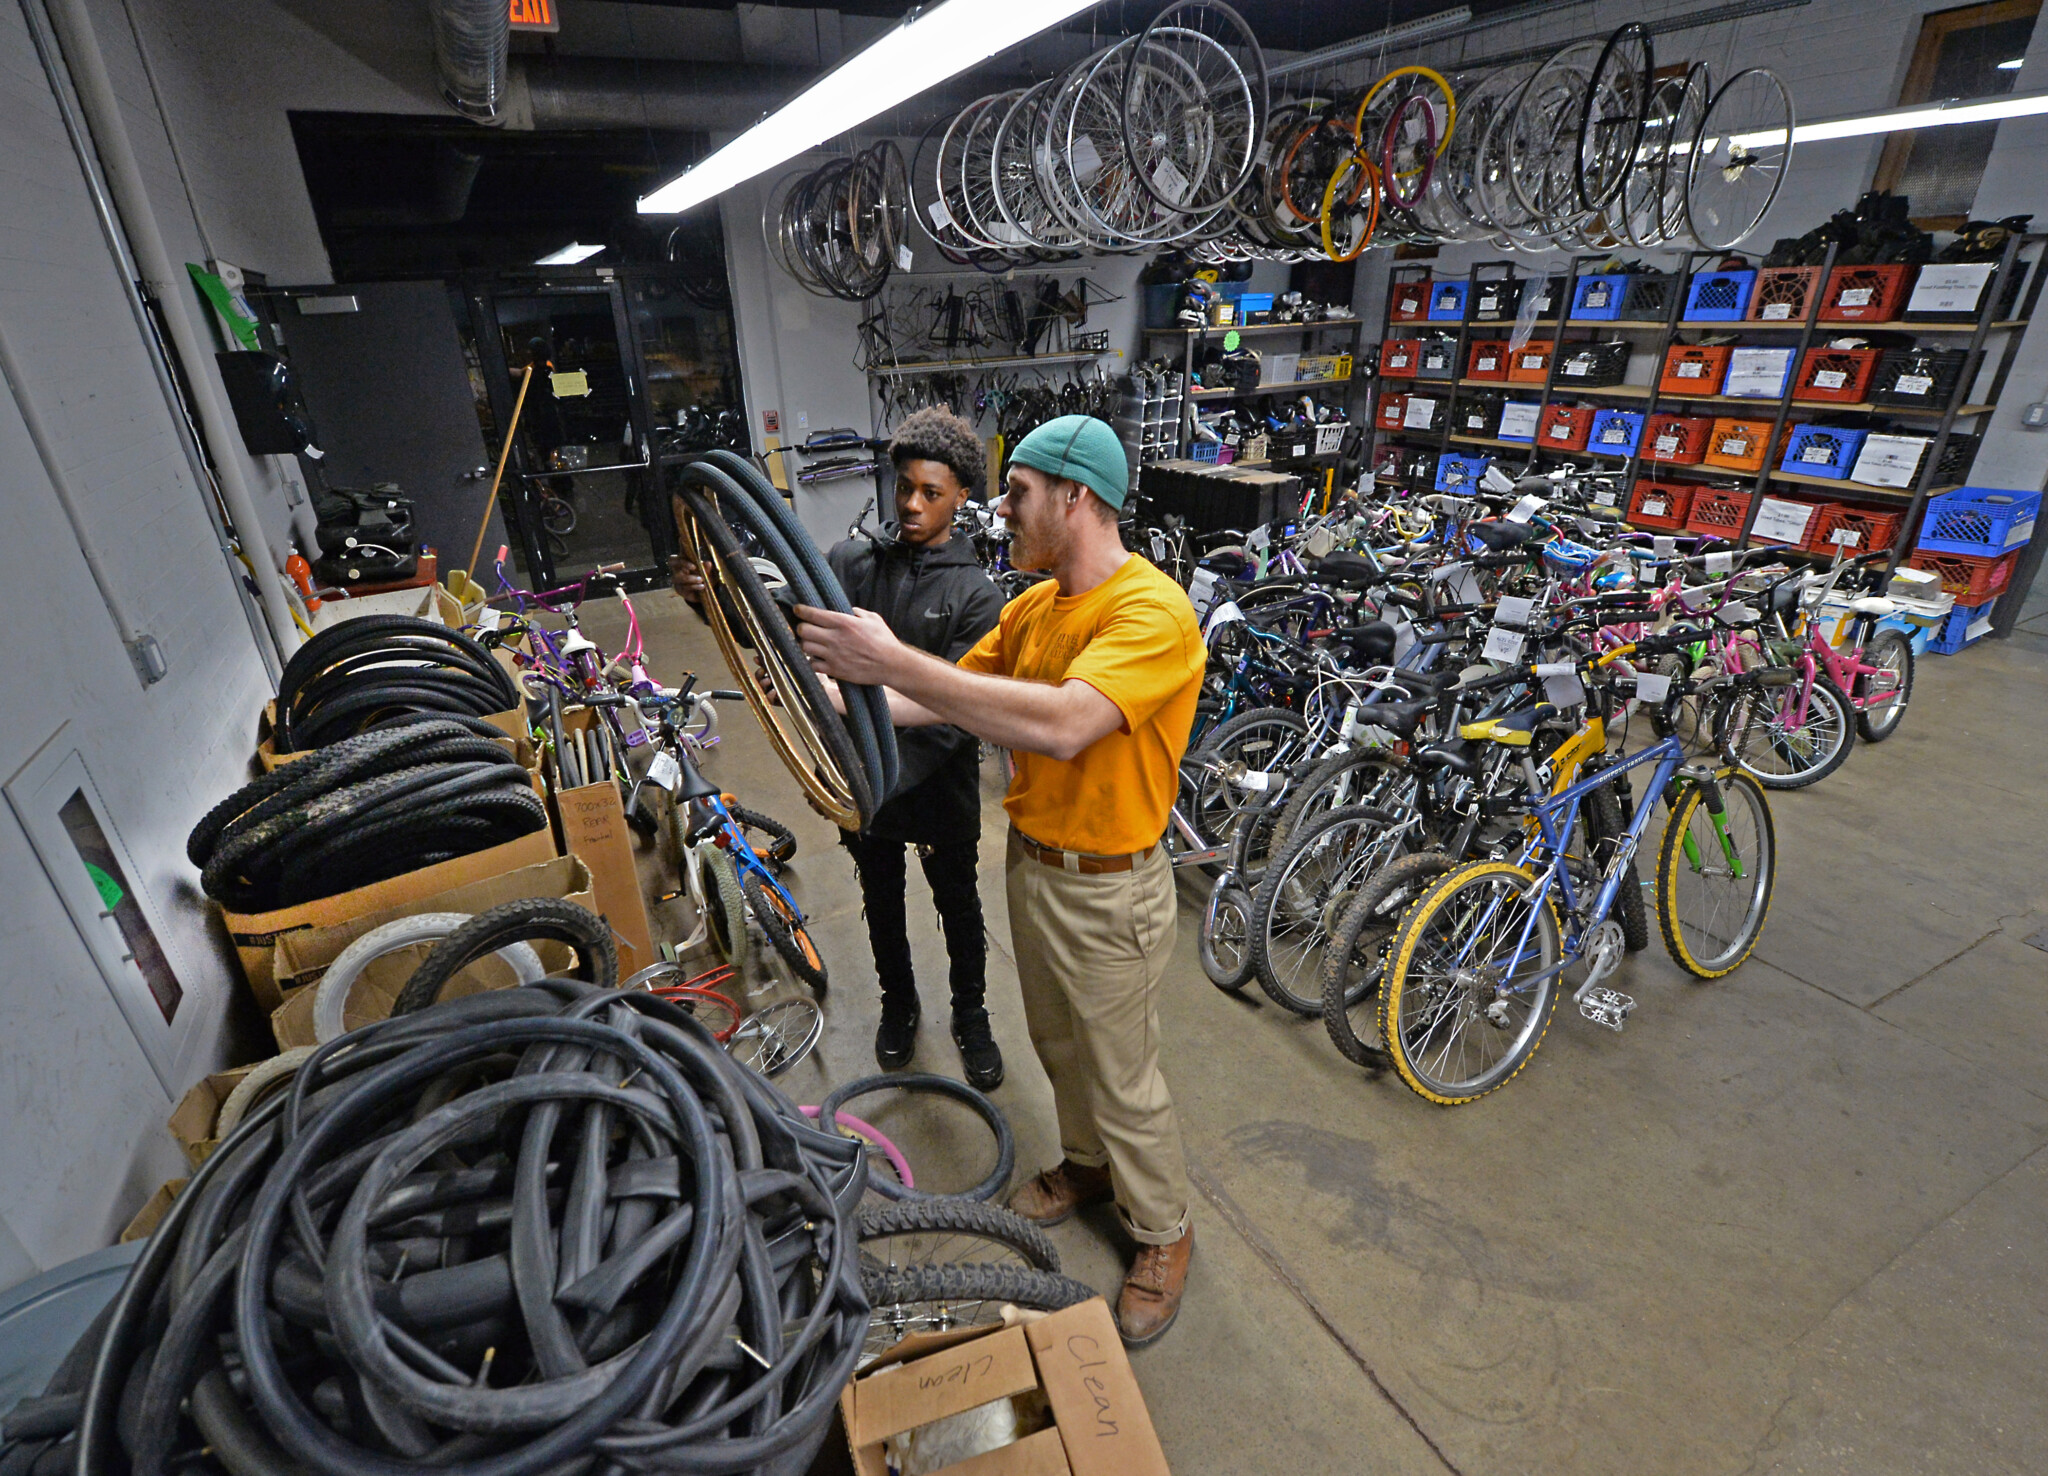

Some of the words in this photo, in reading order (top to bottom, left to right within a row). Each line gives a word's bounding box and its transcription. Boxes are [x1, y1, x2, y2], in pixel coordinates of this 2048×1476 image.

[1599, 764, 1626, 783] OUTPOST
[919, 1354, 993, 1390] Clean
[1067, 1334, 1120, 1437] Clean
